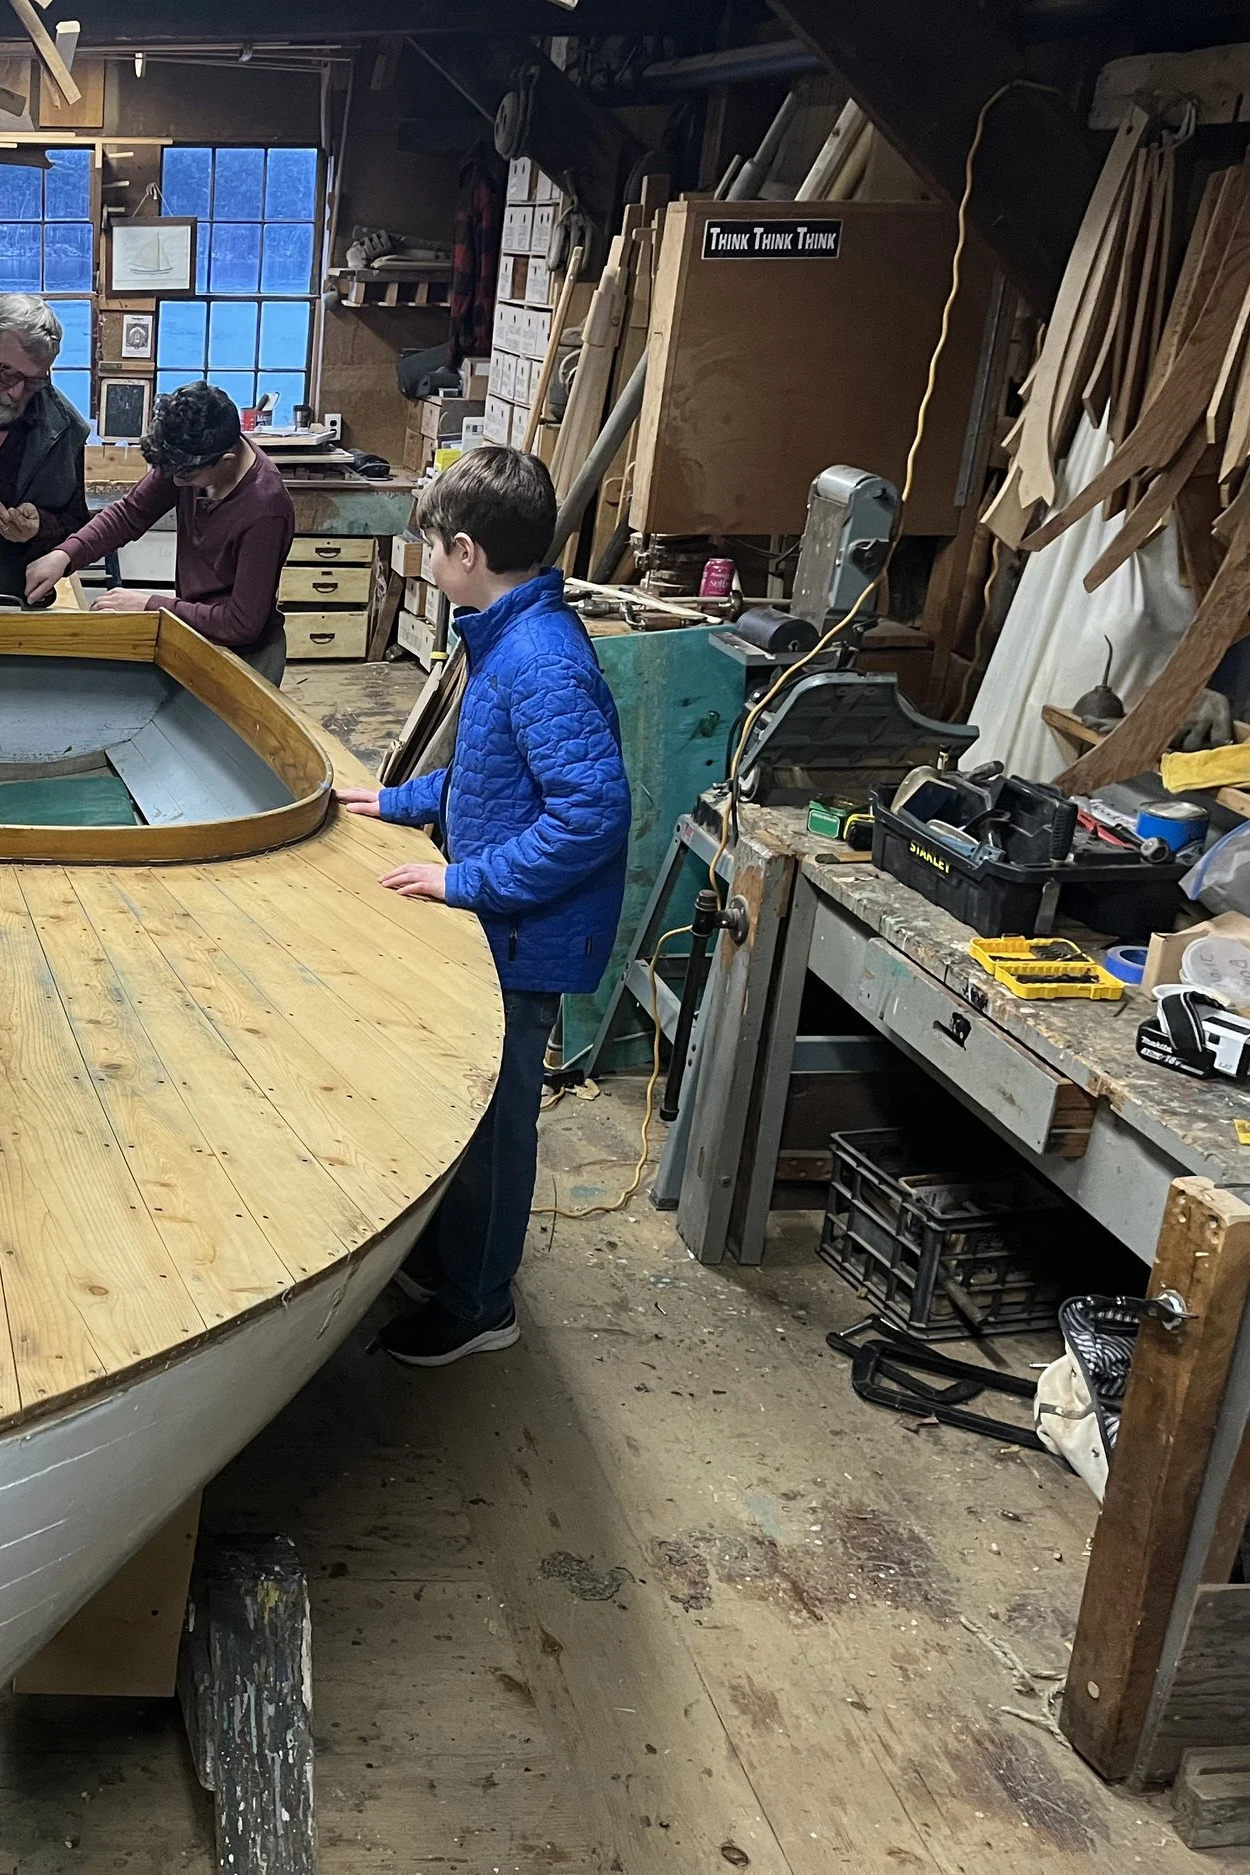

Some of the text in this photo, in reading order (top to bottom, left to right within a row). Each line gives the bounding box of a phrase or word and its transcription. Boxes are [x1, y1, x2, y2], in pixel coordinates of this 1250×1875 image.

[709, 226, 837, 250] THINK THINK THINK
[910, 840, 950, 874] STANLEY
